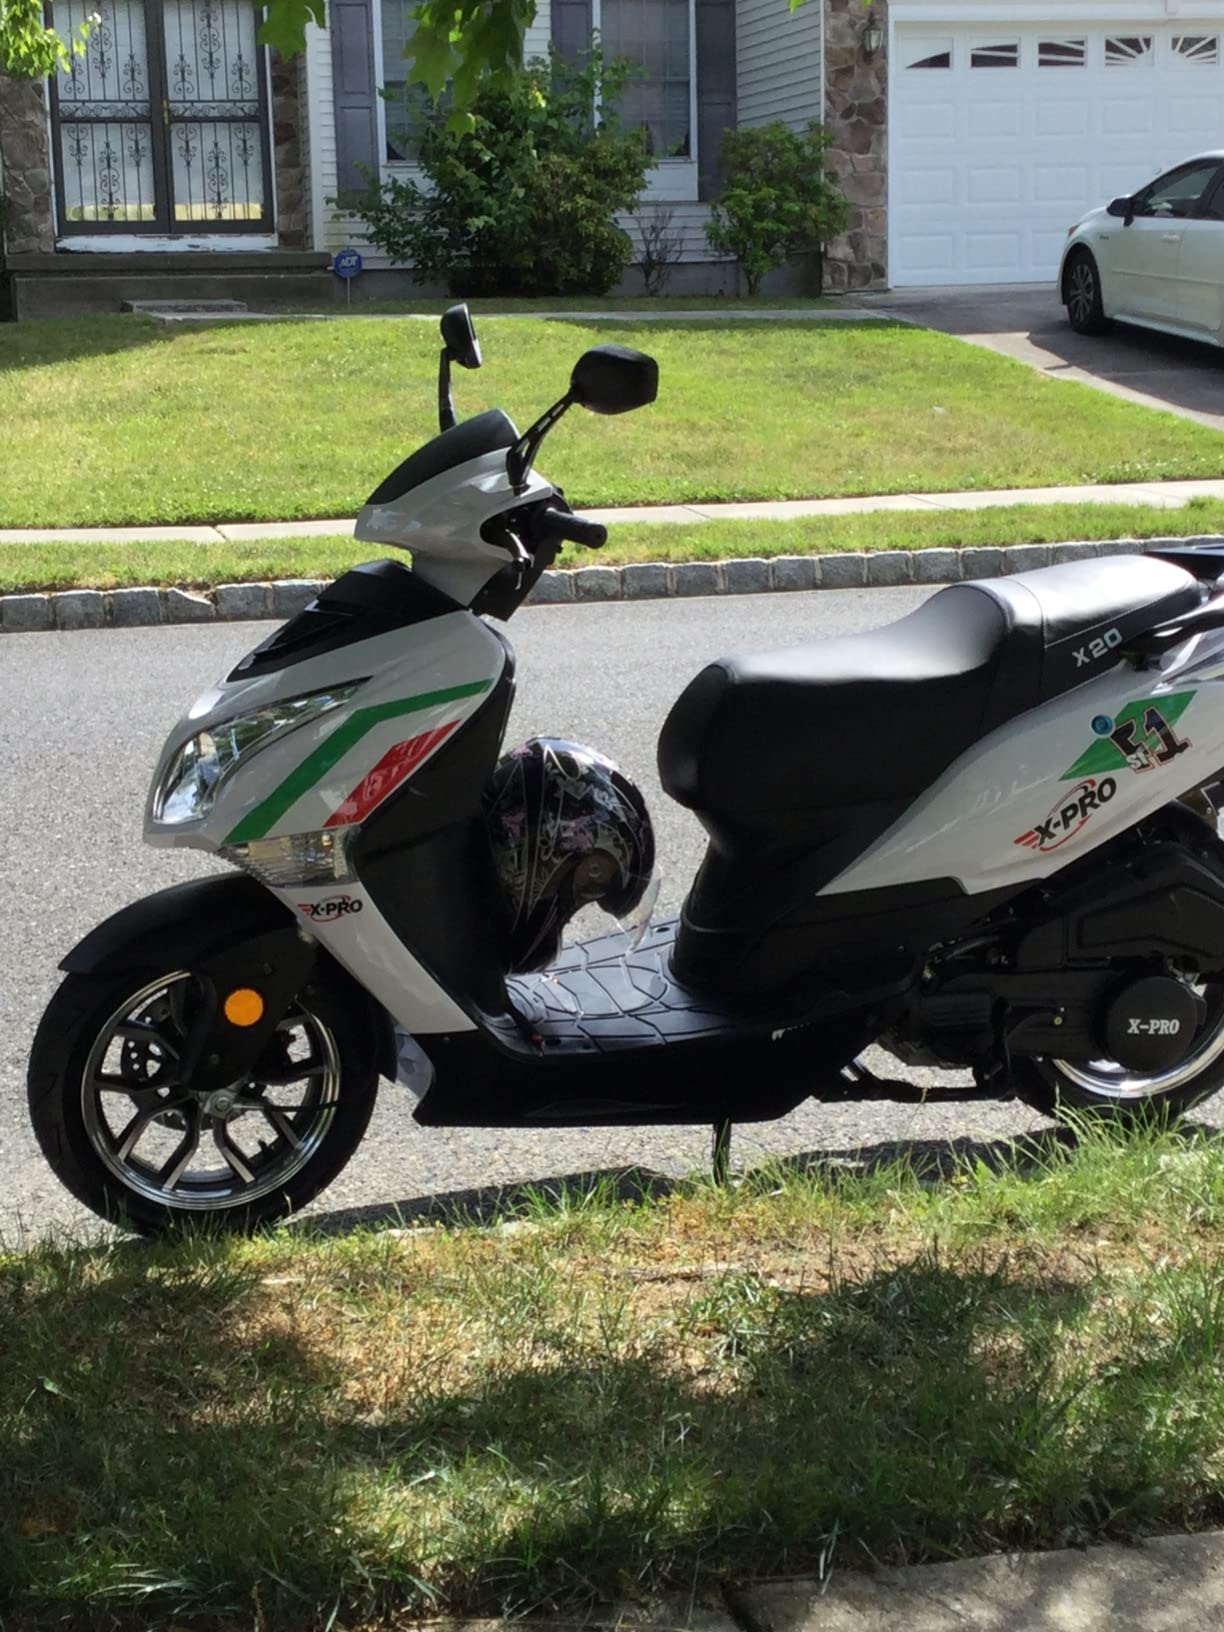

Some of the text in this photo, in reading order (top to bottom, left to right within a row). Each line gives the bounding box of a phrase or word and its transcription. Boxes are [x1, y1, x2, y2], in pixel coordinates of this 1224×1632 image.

[1072, 627, 1122, 667] X20
[1034, 777, 1117, 846] X-PRO
[310, 899, 363, 917] X-PRO
[1127, 1018, 1180, 1035] X-PRO
